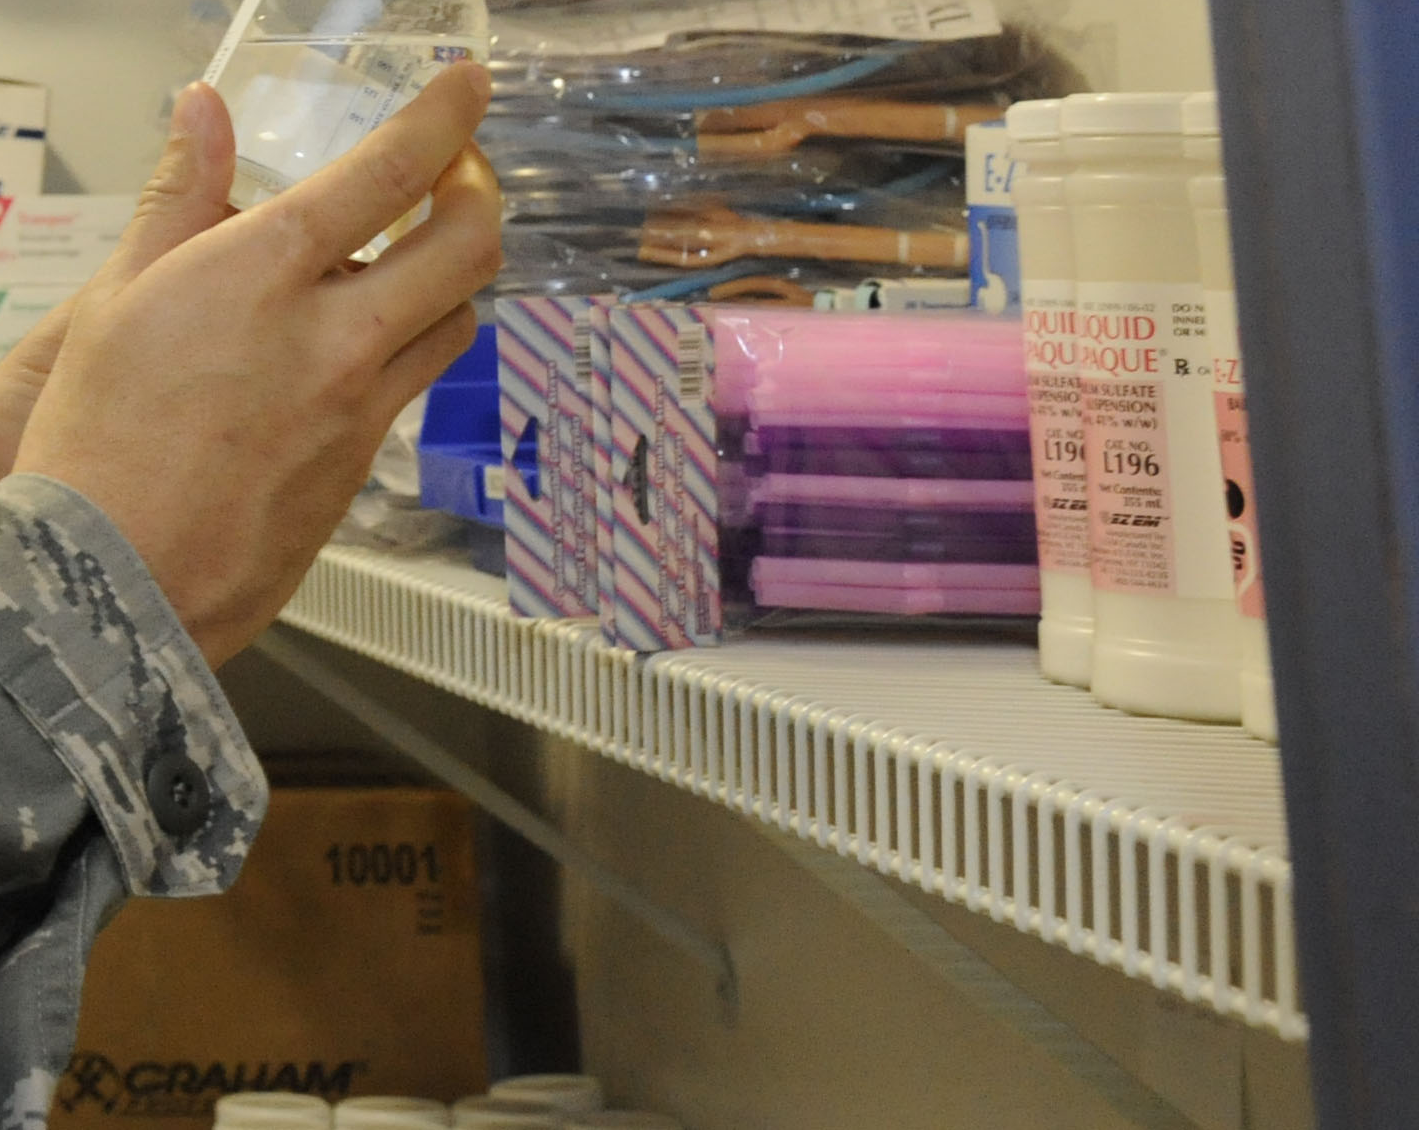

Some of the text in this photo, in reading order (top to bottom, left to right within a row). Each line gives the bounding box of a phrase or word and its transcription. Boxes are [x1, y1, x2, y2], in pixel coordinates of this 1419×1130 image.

[1103, 451, 1160, 477] L196
[325, 843, 442, 886] 10001
[125, 1061, 361, 1095] GRAHAM
